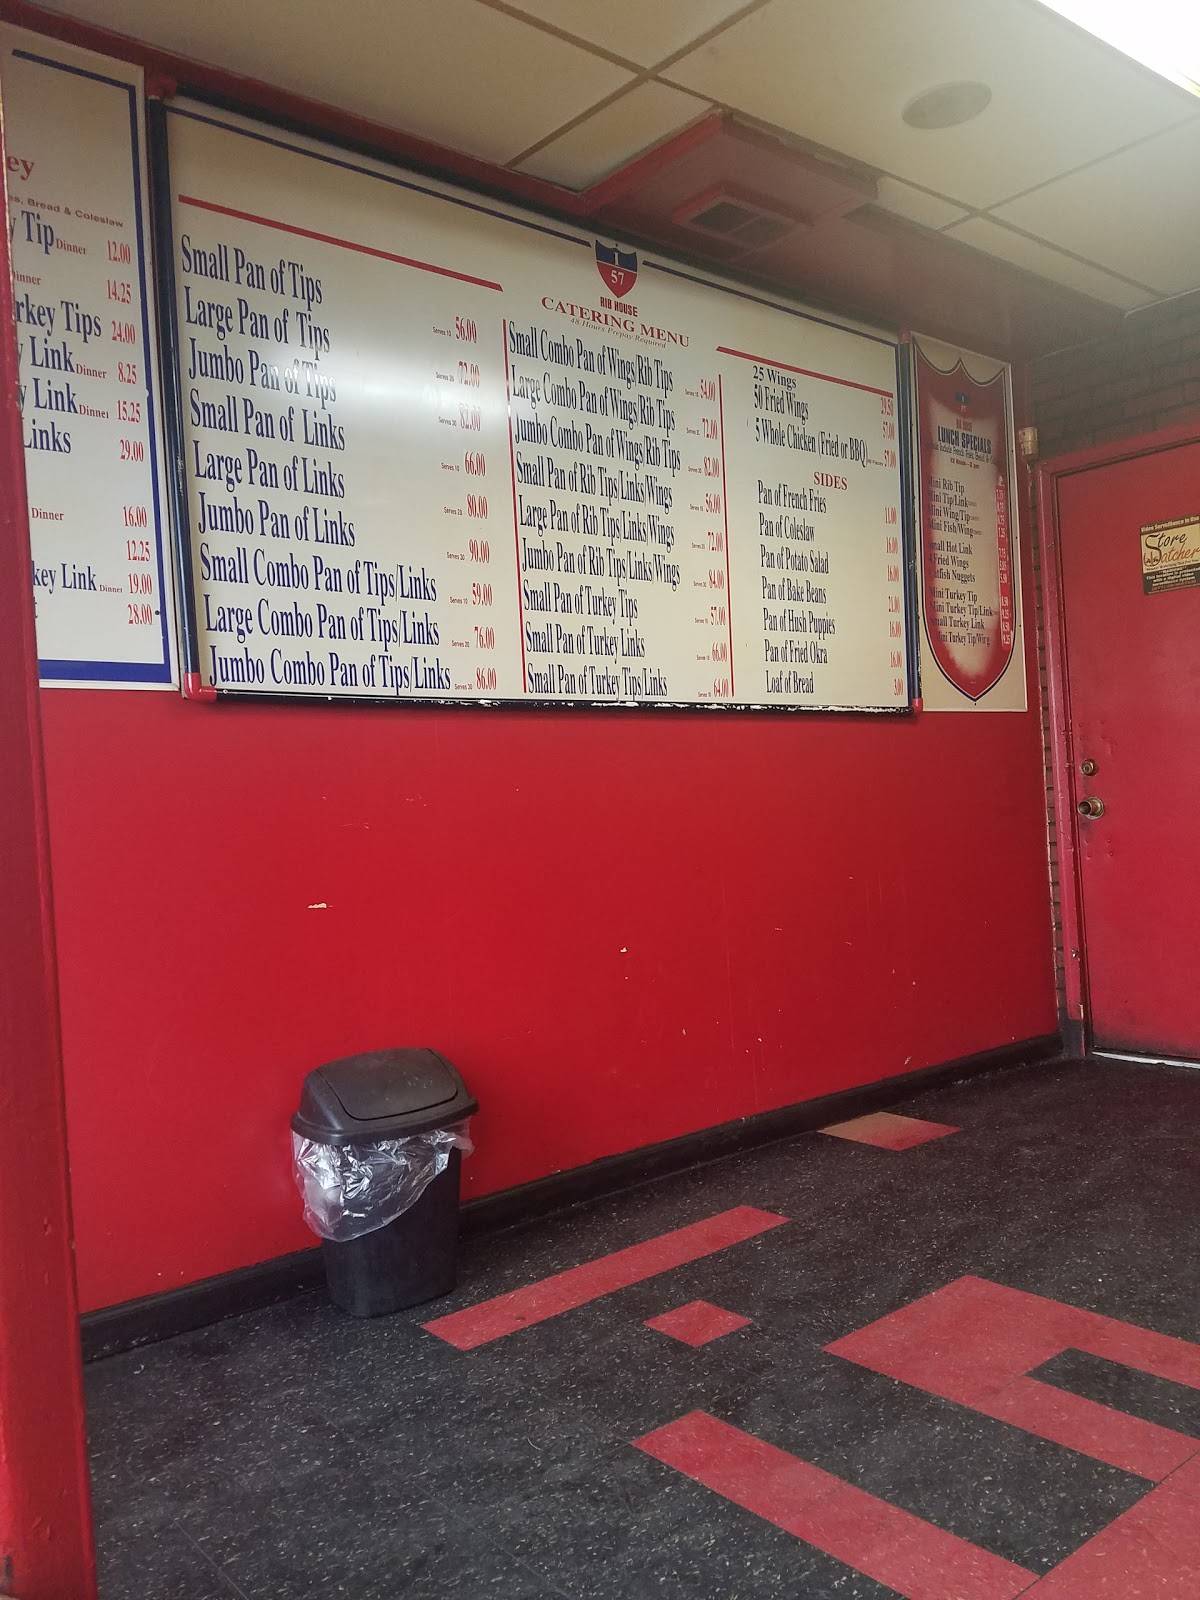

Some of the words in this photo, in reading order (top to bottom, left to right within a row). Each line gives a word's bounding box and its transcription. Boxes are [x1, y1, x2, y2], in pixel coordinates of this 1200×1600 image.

[27, 198, 61, 214] Bread
[64, 207, 71, 215] &
[75, 208, 124, 228] Coleslaw
[21, 210, 54, 255] Tip
[107, 240, 131, 264] 12.00
[181, 234, 229, 282] Small
[234, 248, 265, 291] Pan
[271, 259, 285, 295] of
[288, 262, 322, 311] Tips
[611, 270, 625, 285] 57
[107, 279, 131, 304] 14.25
[600, 296, 612, 311] RIB
[614, 299, 639, 317] HOUSE
[61, 300, 101, 344] Tips
[112, 320, 136, 344] 24.00
[184, 286, 233, 340] Large
[237, 298, 269, 340] Pan
[274, 309, 289, 344] of
[296, 311, 330, 360] Tips
[455, 316, 477, 343] 56.00
[541, 297, 635, 333] CATERING
[640, 324, 690, 348] MENU
[581, 319, 605, 334] Hours
[635, 334, 667, 349] Required
[29, 335, 75, 374] Link
[76, 363, 107, 379] Dinner
[509, 321, 538, 359] Small
[540, 329, 574, 368] Combo
[576, 338, 595, 373] Pan
[597, 344, 607, 376] of
[654, 357, 673, 398] Tips
[118, 361, 137, 385] 8.25
[458, 360, 480, 388] 72.00
[753, 365, 765, 381] 25
[767, 368, 797, 391] Wings
[32, 377, 78, 415] Link
[754, 384, 763, 409] 50
[765, 386, 785, 414] Fried
[786, 390, 809, 425] Wings
[117, 400, 141, 423] 15.25
[190, 388, 239, 432] Small
[242, 397, 275, 438] Pan
[280, 406, 295, 442] of
[302, 408, 345, 451] Links
[120, 439, 144, 462] 29.00
[755, 417, 760, 442] 5
[762, 418, 786, 447] Whole
[787, 423, 816, 453] Chicken
[818, 431, 839, 458] (Fried
[840, 443, 848, 459] or
[849, 437, 868, 468] BBQ)
[937, 426, 959, 447] LUNCH
[961, 429, 992, 454] SPECIALS
[193, 440, 242, 492] Large
[246, 448, 279, 488] Pan
[283, 455, 299, 491] of
[302, 457, 345, 498] Links
[465, 451, 486, 476] 66.00
[516, 451, 545, 487] Small
[547, 457, 566, 490] Pan
[569, 461, 578, 492] of
[579, 462, 596, 496] Rib
[814, 471, 848, 491] SIDES
[467, 493, 488, 519] 80.00
[758, 479, 772, 505] Pan
[774, 483, 782, 507] of
[783, 484, 808, 511] French
[809, 488, 827, 513] Fries
[31, 507, 64, 521] Dinner
[123, 506, 147, 528] 16.00
[198, 491, 254, 534] Jumbo
[258, 500, 290, 539] Pan
[295, 506, 309, 541] of
[312, 507, 355, 547] Links
[759, 512, 774, 537] Pan
[775, 515, 783, 538] of
[784, 515, 815, 542] Coleslaw
[126, 540, 150, 562] 12.25
[469, 539, 490, 564] 90.00
[760, 544, 775, 569] Pan
[777, 546, 785, 569] of
[785, 547, 808, 572] Potato
[809, 549, 829, 574] Salad
[958, 542, 973, 555] Link
[61, 563, 97, 592] Link
[128, 573, 152, 596] 19.00
[200, 542, 249, 584] Small
[253, 548, 309, 590] Combo
[313, 555, 343, 593] Pan
[347, 560, 361, 594] of
[363, 561, 437, 606] Tips/Links
[472, 582, 493, 607] 59.00
[523, 579, 551, 612] Small
[553, 583, 572, 614] Pan
[574, 585, 584, 616] of
[585, 586, 617, 625] Turkey
[618, 588, 638, 626] Tips
[762, 576, 776, 600] Pan
[778, 578, 785, 601] of
[787, 578, 804, 602] Bake
[805, 580, 827, 604] Beans
[128, 603, 153, 625] 28.00
[203, 594, 253, 643] Large
[257, 598, 313, 638] Combo
[316, 603, 347, 640] Pan
[350, 607, 364, 641] of
[366, 608, 440, 652] Tips/Links
[763, 607, 778, 632] Pan
[779, 609, 787, 632] of
[788, 609, 807, 633] Hush
[808, 610, 836, 641] Puppies
[474, 626, 495, 650] 76.00
[764, 639, 780, 662] Pan
[781, 640, 788, 663] of
[789, 640, 808, 664] Fried
[810, 641, 828, 664] Okra
[209, 645, 265, 687] Jumbo
[270, 648, 325, 686] Combo
[329, 652, 359, 688] Pan
[362, 655, 376, 688] of
[378, 655, 451, 696] Tips/Links
[476, 667, 497, 690] 86.00
[527, 663, 555, 694] Small
[557, 664, 576, 694] Pan
[579, 665, 588, 695] of
[589, 666, 620, 700] Turkey
[765, 670, 783, 694] Loaf
[785, 671, 792, 694] of
[792, 671, 814, 694] Bread
